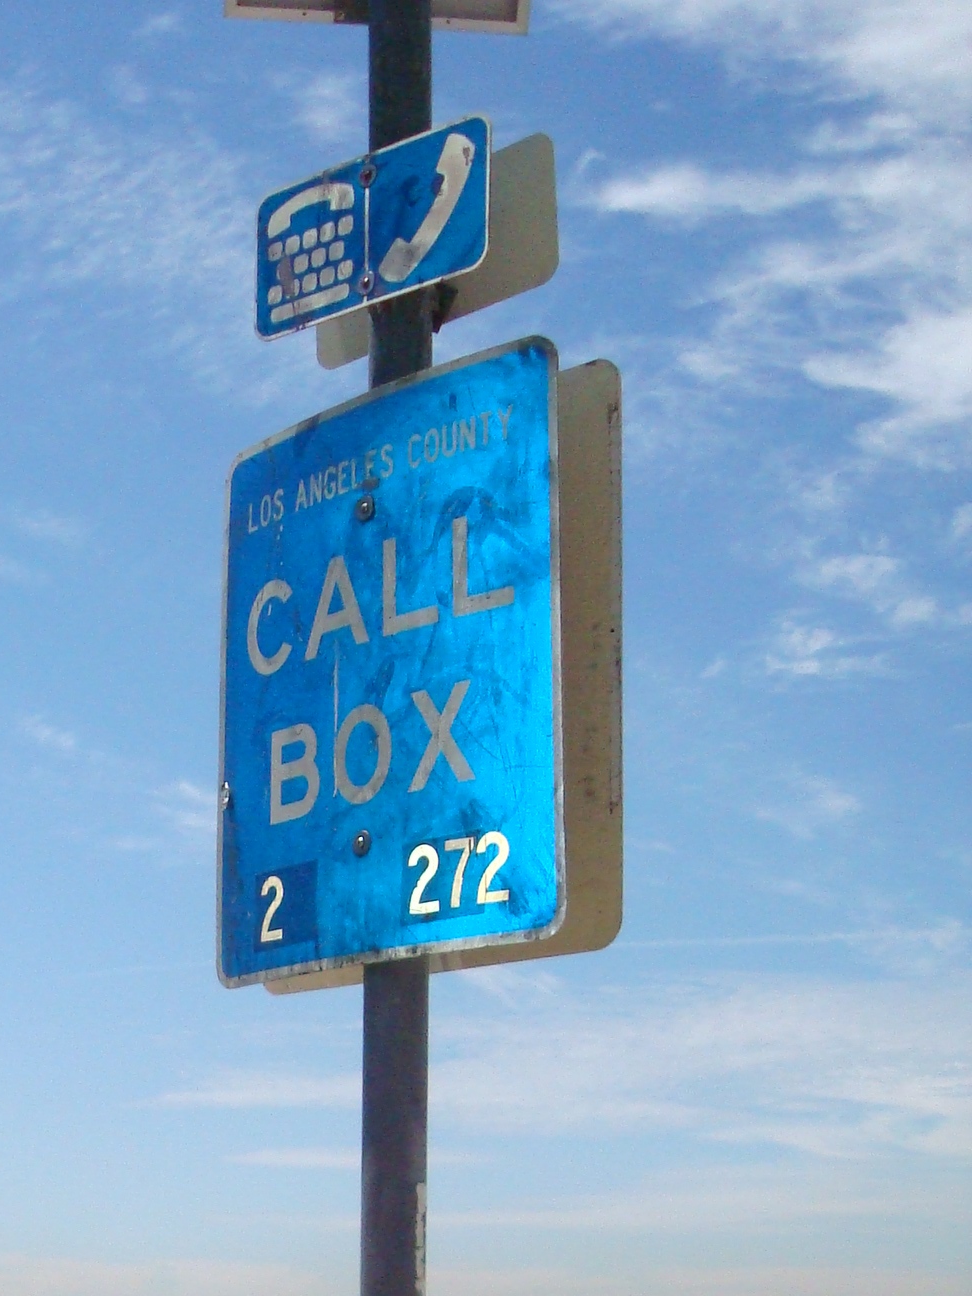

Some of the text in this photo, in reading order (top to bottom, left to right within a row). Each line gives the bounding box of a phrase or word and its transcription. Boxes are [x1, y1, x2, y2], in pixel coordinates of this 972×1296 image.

[247, 405, 514, 533] LOS ANGELES COUNTY
[247, 517, 515, 675] CALL
[270, 680, 475, 825] BOX
[260, 831, 510, 943] 2 272
